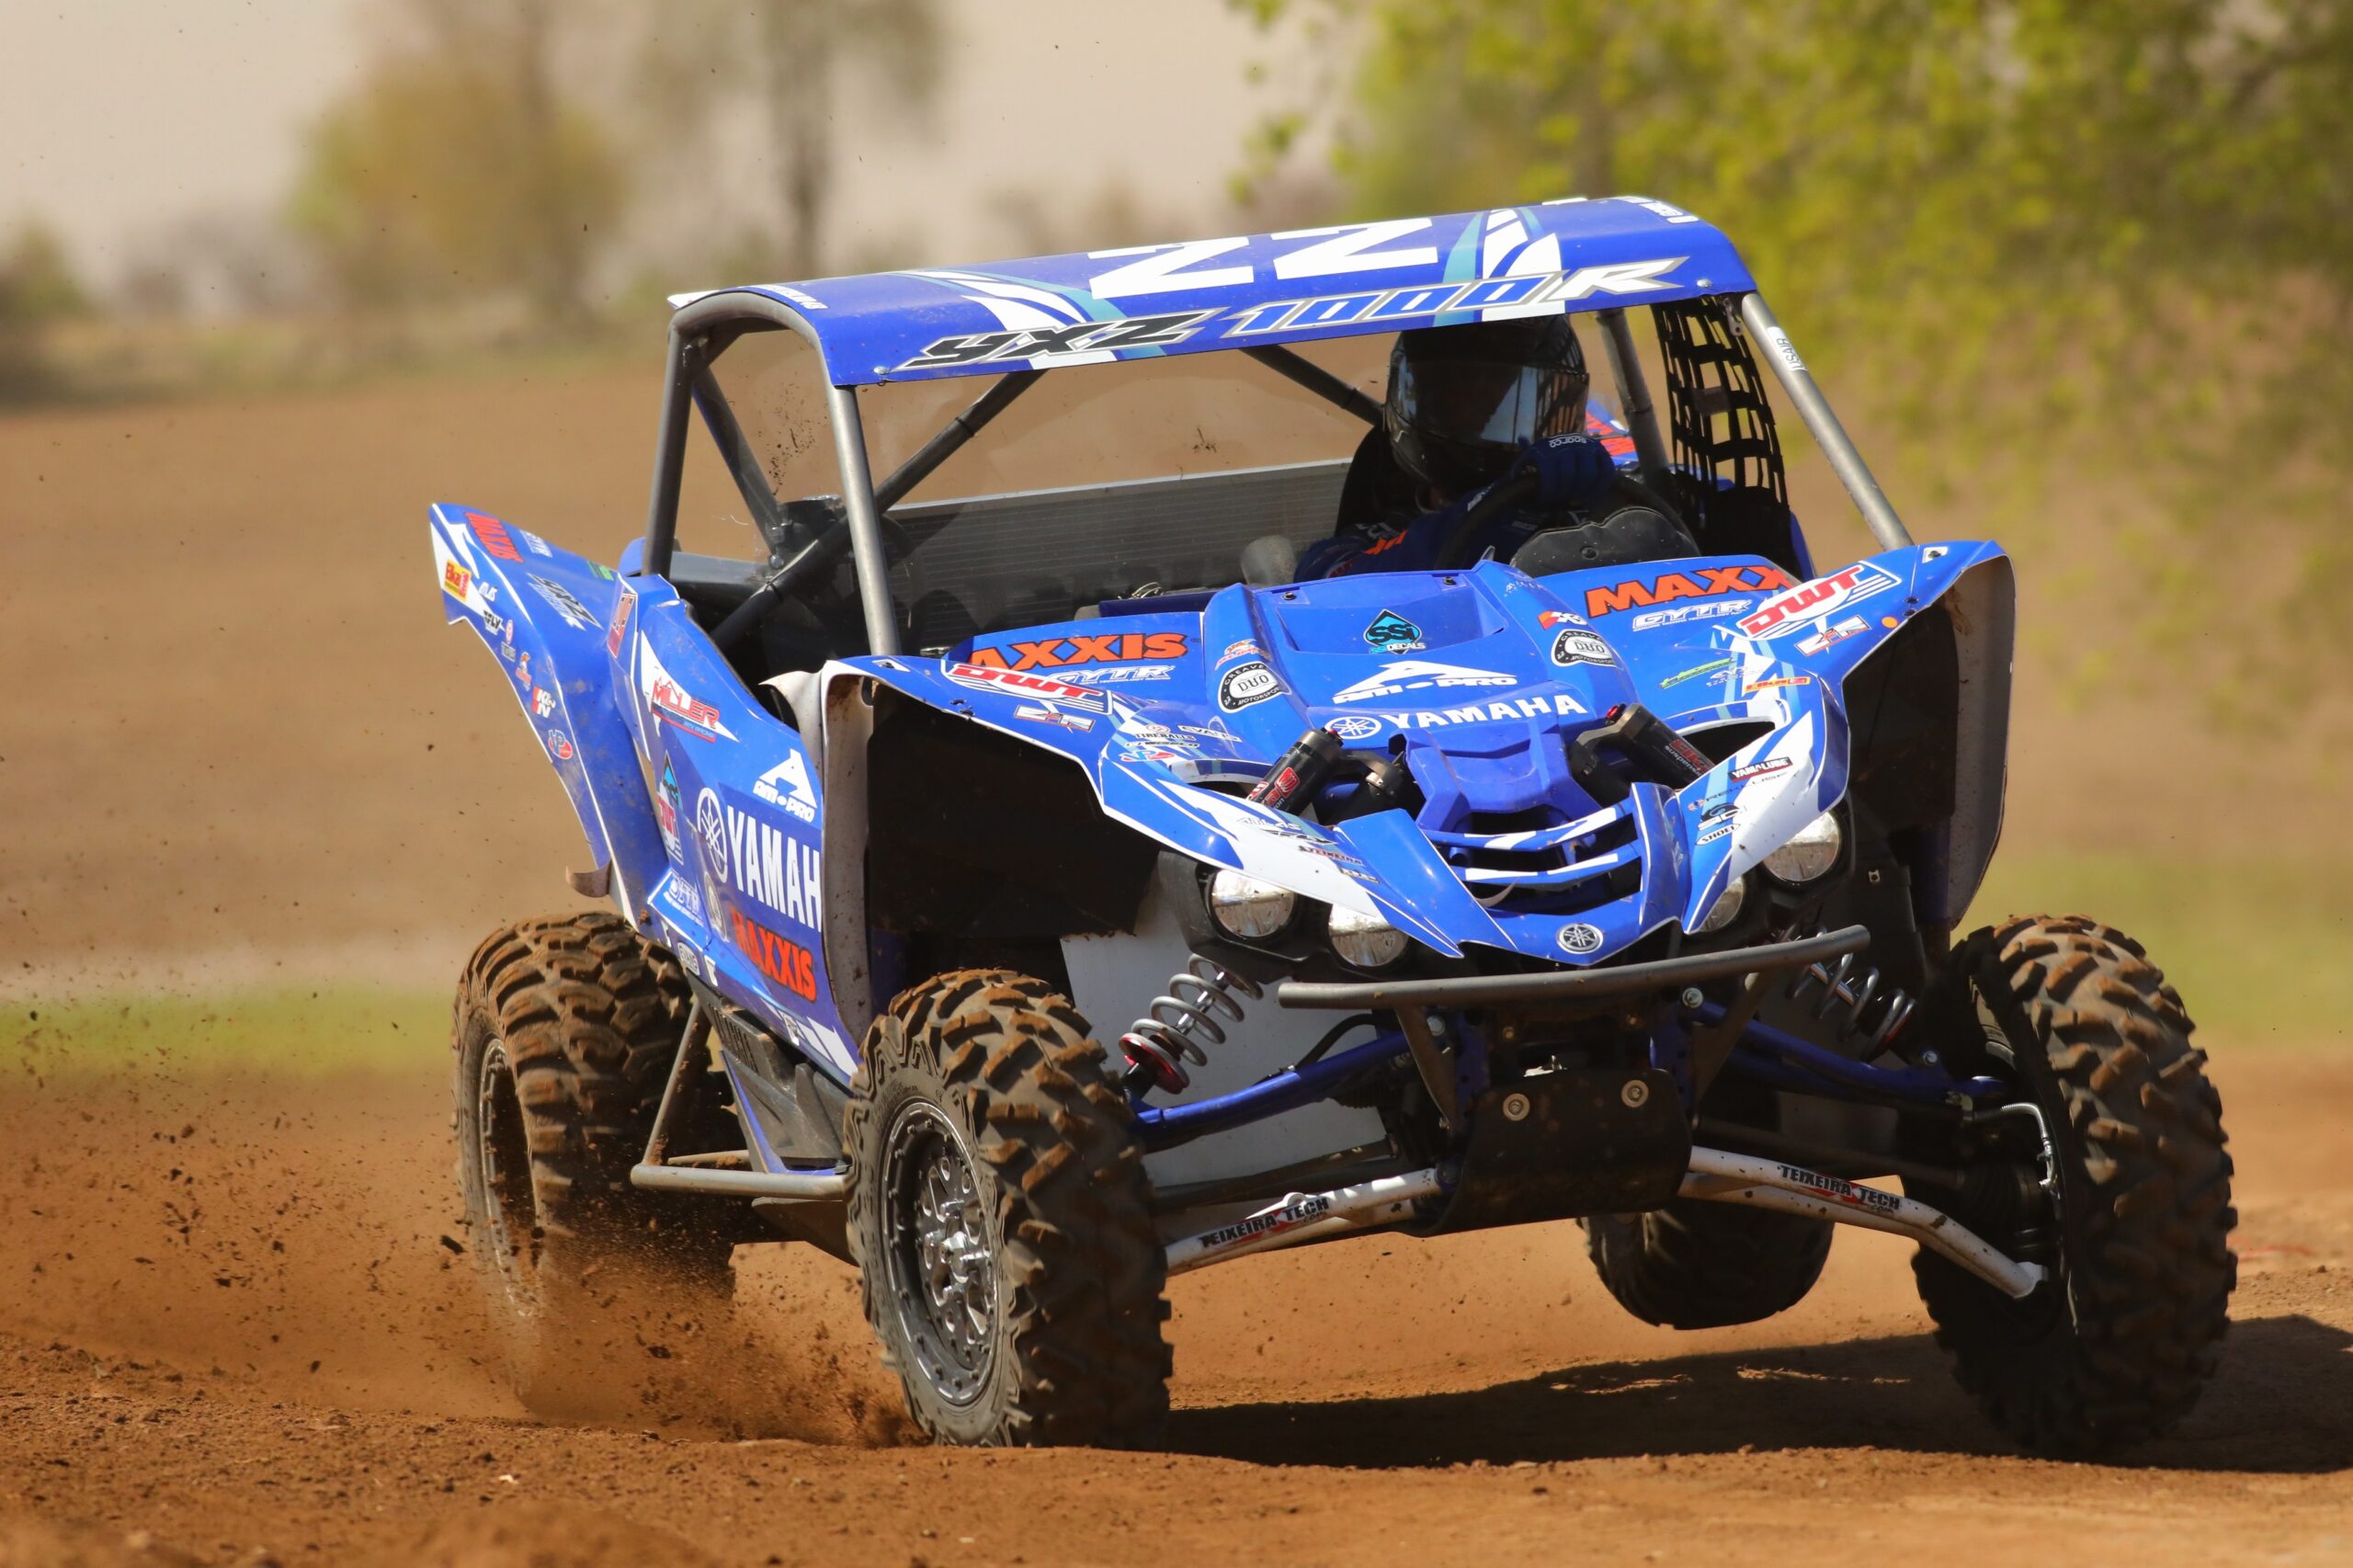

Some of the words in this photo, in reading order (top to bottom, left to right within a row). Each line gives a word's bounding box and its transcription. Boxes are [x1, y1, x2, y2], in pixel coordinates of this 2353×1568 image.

[1586, 565, 1794, 618] MAXX
[1739, 564, 1864, 637] DWT
[968, 632, 1188, 671] AXXIS
[1237, 674, 1269, 691] DUO
[1381, 694, 1588, 730] YAMAHA
[727, 805, 822, 932] YAMAH
[1779, 1165, 1852, 1197] TEIXEIRA
[1859, 1187, 1900, 1210] TECH
[1199, 1213, 1277, 1247] TEIXEIRA
[1283, 1198, 1329, 1221] TECH
